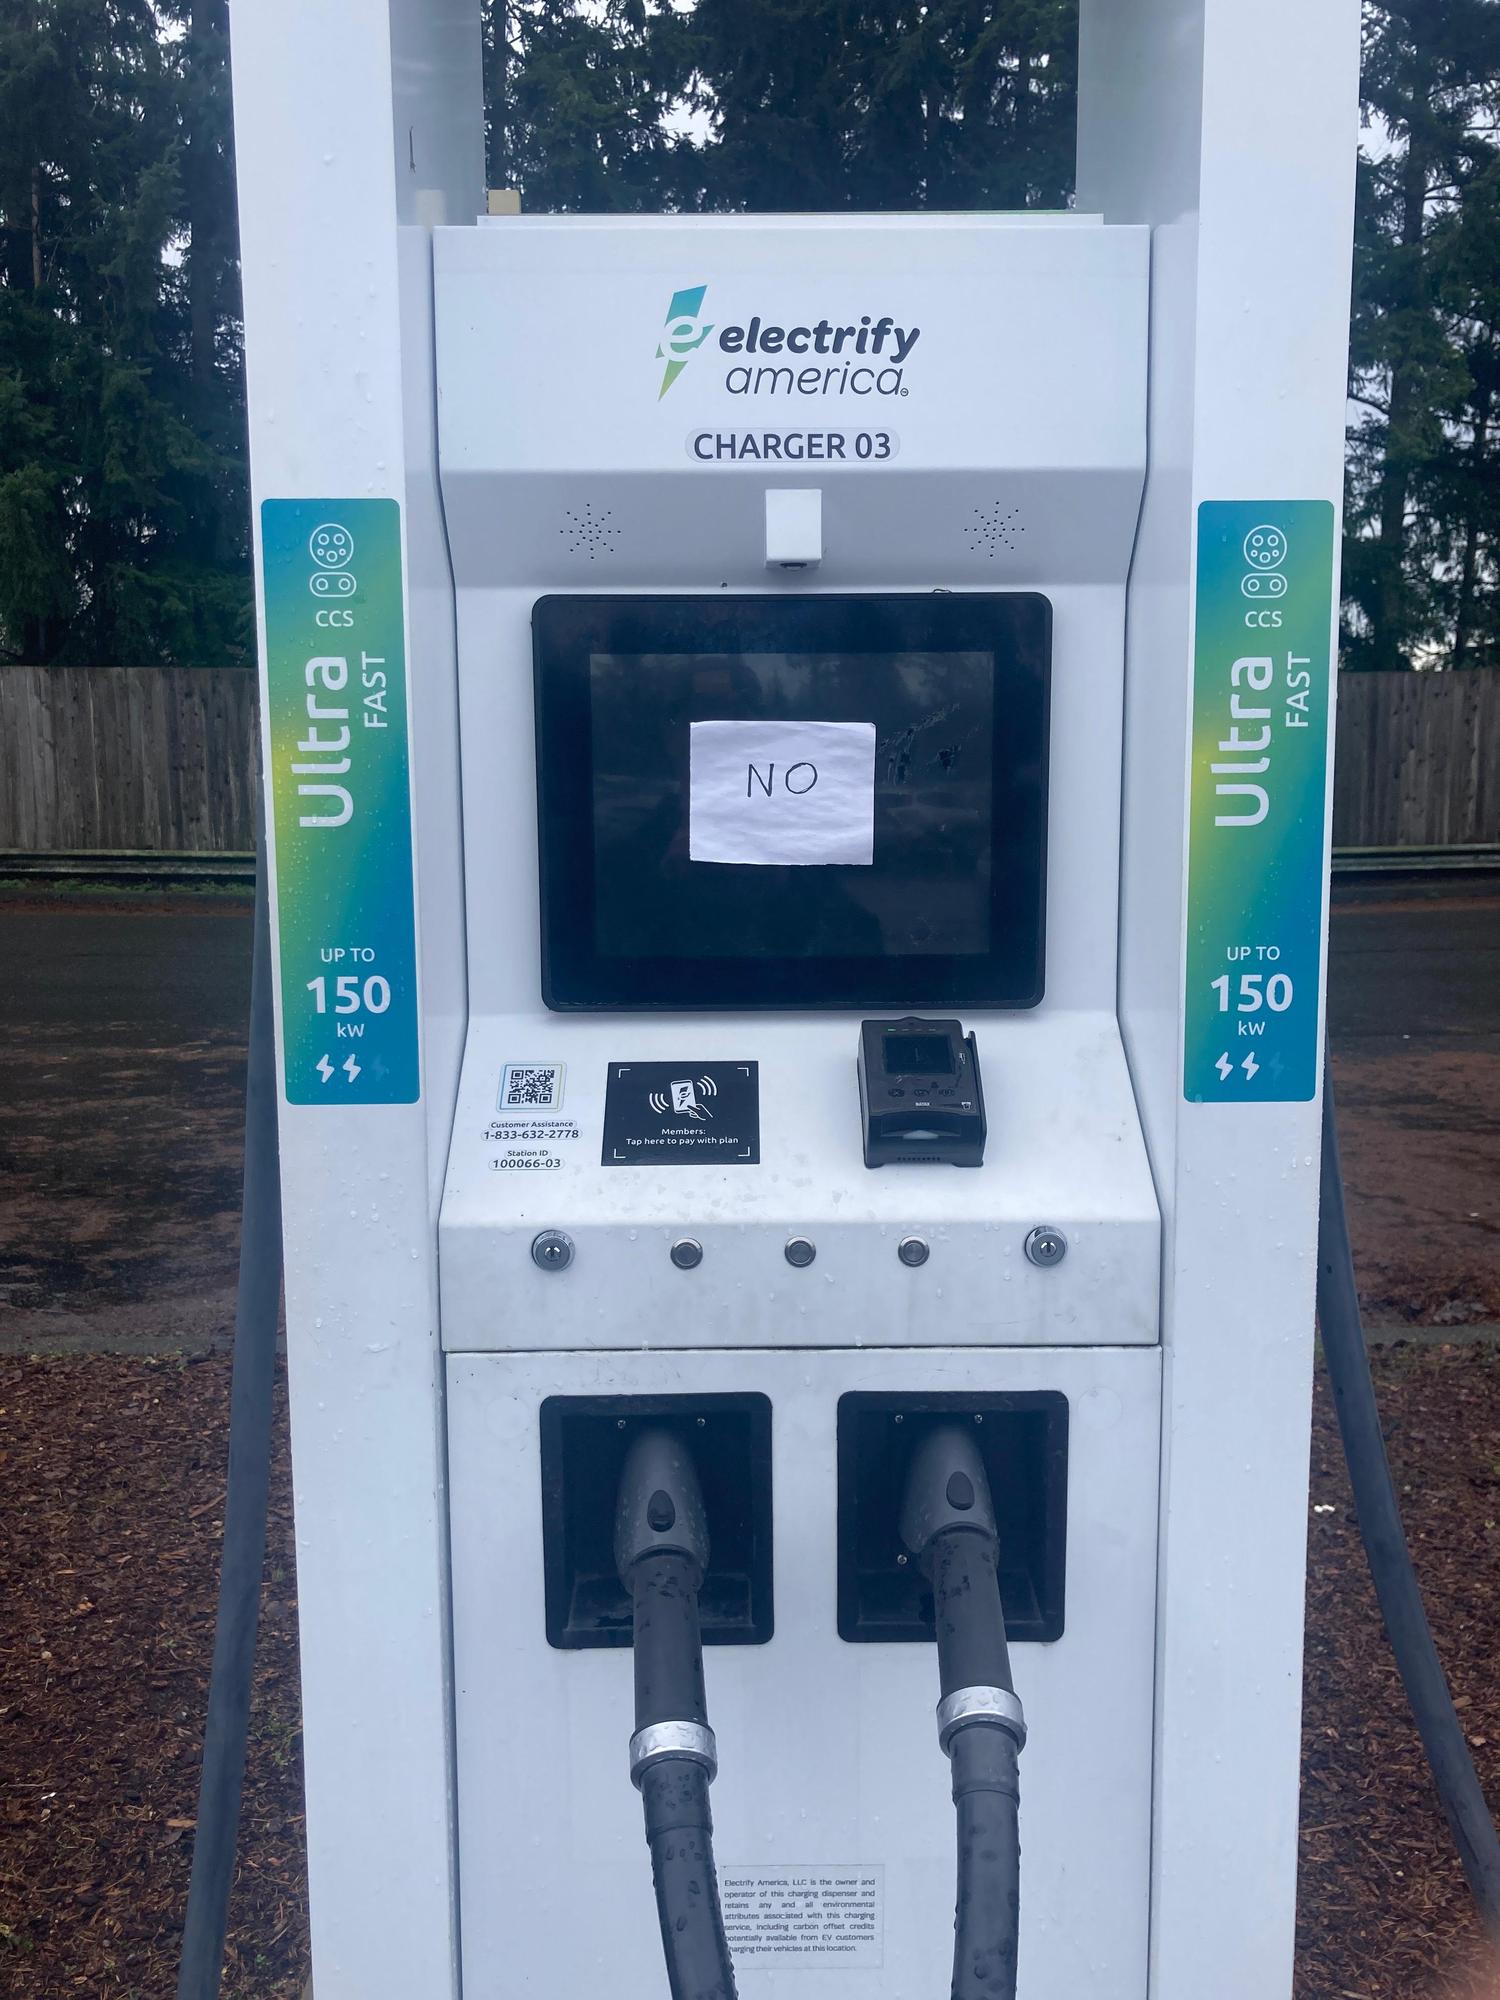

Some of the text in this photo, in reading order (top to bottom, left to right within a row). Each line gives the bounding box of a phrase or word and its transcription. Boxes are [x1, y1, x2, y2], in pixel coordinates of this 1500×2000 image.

[718, 316, 921, 363] electrify
[725, 361, 903, 395] america
[694, 433, 891, 459] CHARGER 03
[315, 610, 354, 627] CCS
[1244, 611, 1282, 627] CCS
[361, 651, 387, 728] FAST
[1285, 651, 1311, 728] FAST
[291, 656, 354, 827] Ultra
[1210, 656, 1273, 826] Ultra
[747, 762, 818, 798] NO
[320, 948, 375, 962] UP TO
[1227, 946, 1280, 961] UP TO
[306, 975, 391, 1014] 150
[1210, 973, 1294, 1012] 150
[337, 1022, 364, 1038] kW
[1238, 1020, 1265, 1036] kW
[490, 1121, 530, 1129] Customer
[661, 1128, 706, 1136] Members:
[484, 1129, 579, 1140] 1-833-632-2778
[626, 1138, 642, 1146] Tap
[679, 1138, 695, 1146] pay
[697, 1136, 717, 1144] with
[719, 1136, 739, 1145] plan
[493, 1158, 561, 1169] 100066-03
[724, 1878, 755, 1888] Electrify
[757, 1878, 790, 1886] America,
[792, 1878, 808, 1886] LLC
[810, 1878, 817, 1886] is
[819, 1878, 832, 1886] the
[860, 1878, 876, 1886] and
[724, 1890, 756, 1900] operator
[787, 1890, 819, 1900] charging
[821, 1890, 858, 1898] dispenser
[843, 1912, 876, 1921] charging
[756, 1924, 790, 1932] including
[728, 1946, 756, 1954] harging
